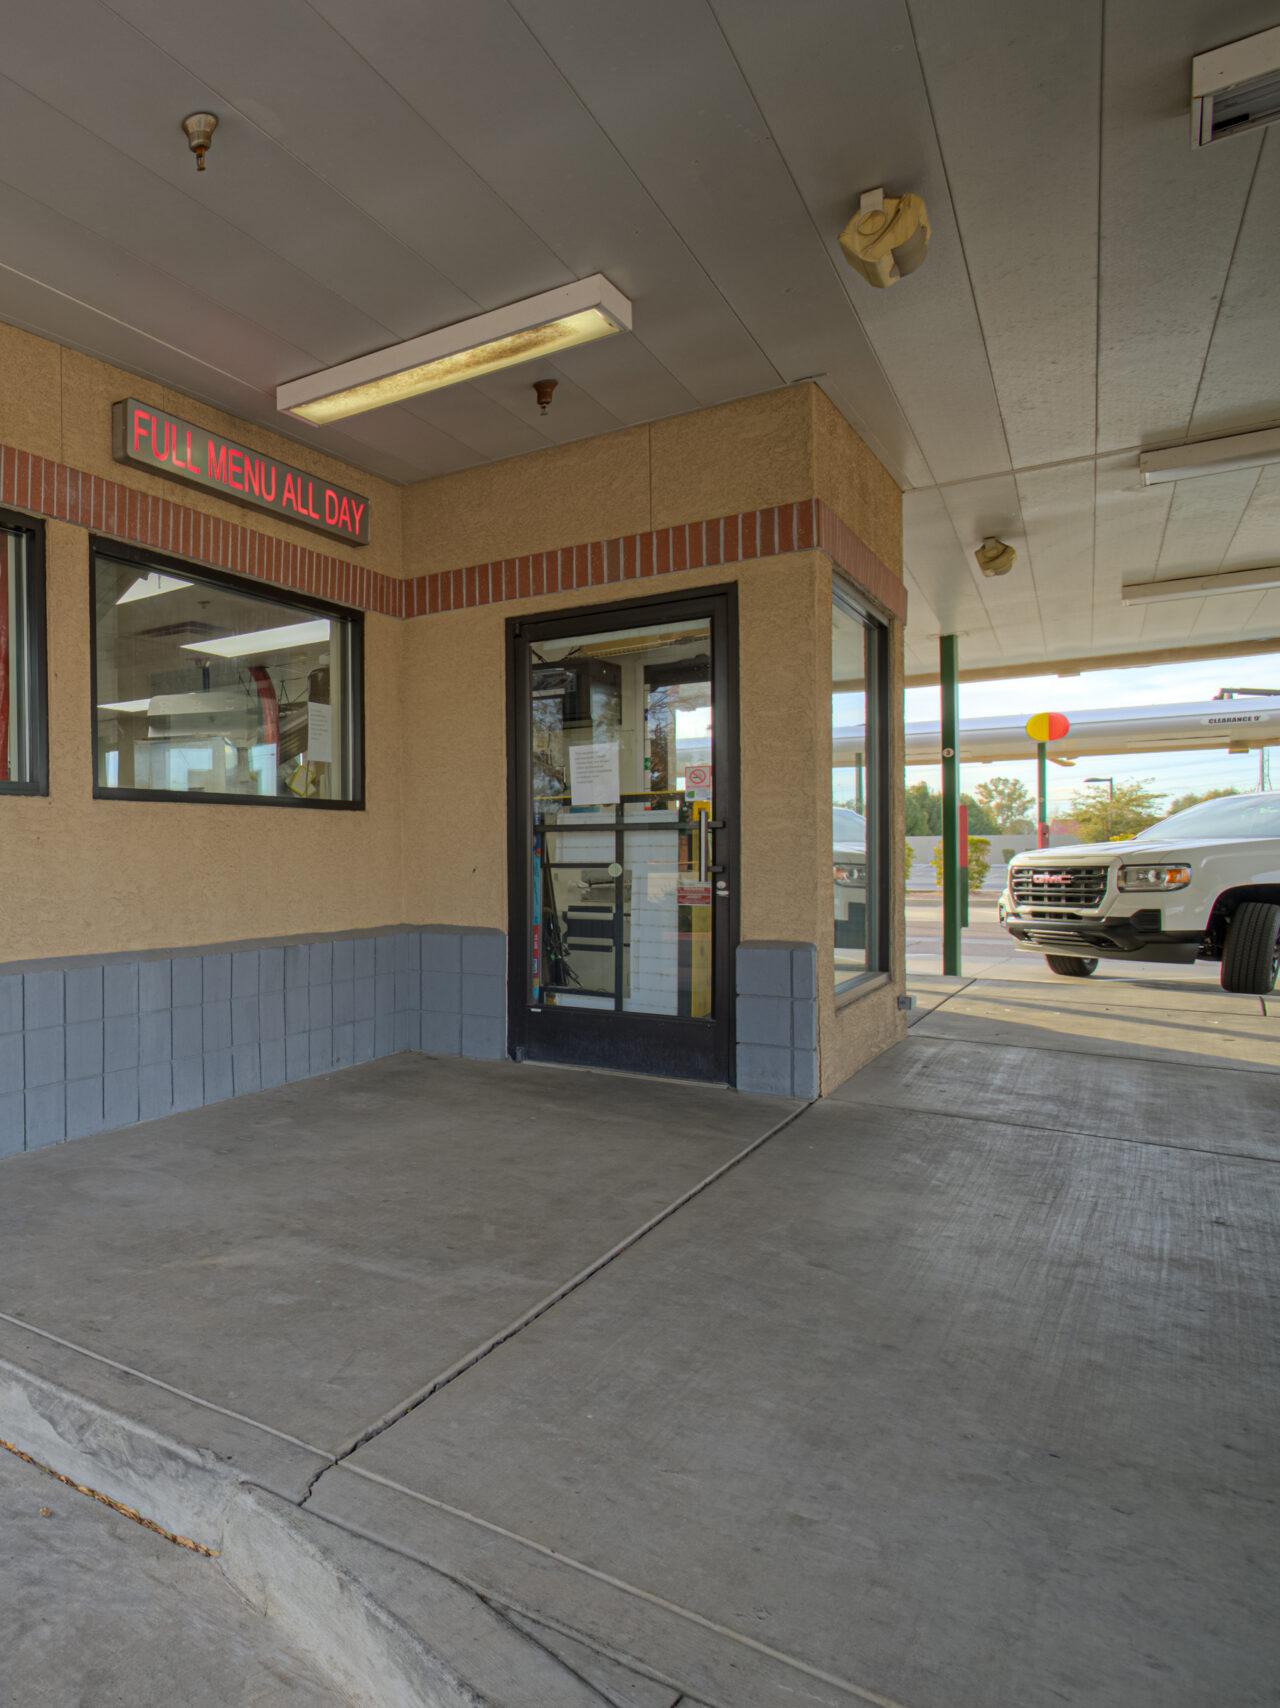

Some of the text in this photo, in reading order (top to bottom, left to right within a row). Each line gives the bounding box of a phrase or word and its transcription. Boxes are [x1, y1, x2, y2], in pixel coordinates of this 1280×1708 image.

[133, 409, 365, 535] FULL MENU ALL DAY
[1208, 716, 1252, 724] CLEARANCE
[1033, 874, 1072, 884] GMC
